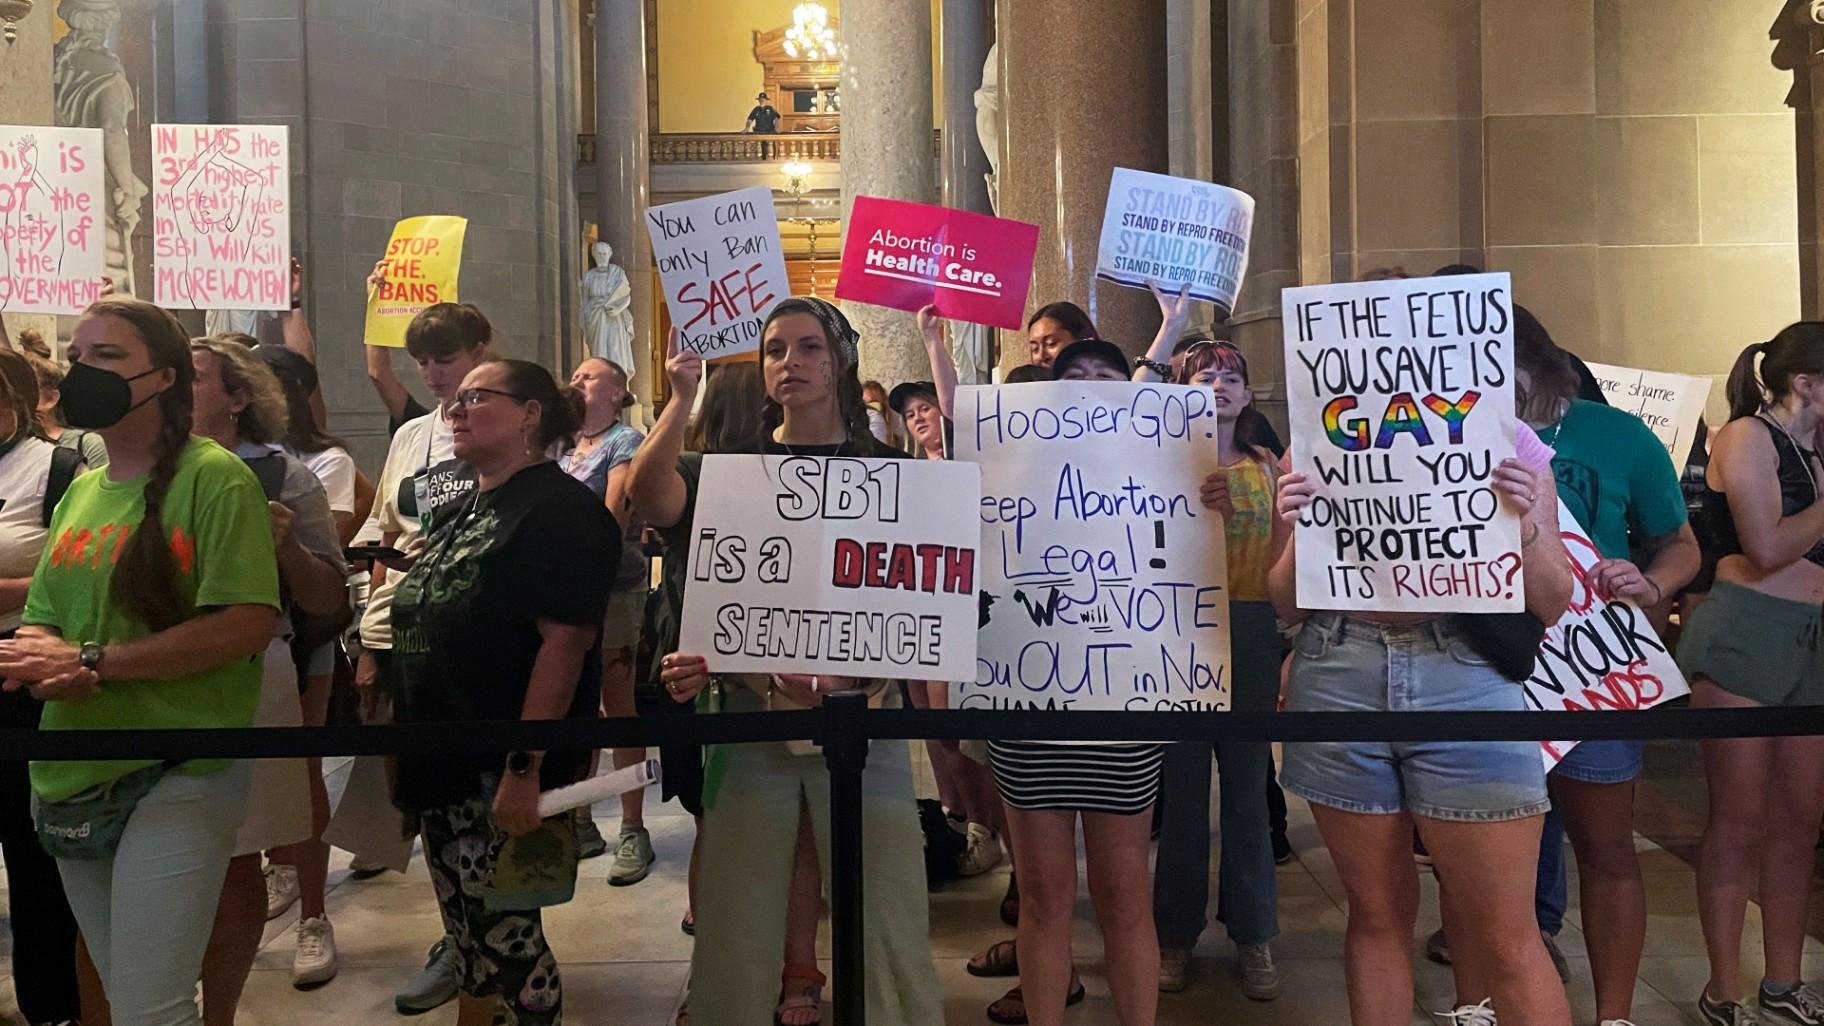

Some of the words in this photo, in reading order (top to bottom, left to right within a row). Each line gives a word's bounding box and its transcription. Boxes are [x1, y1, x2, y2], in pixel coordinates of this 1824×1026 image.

[59, 141, 85, 173] is
[157, 127, 177, 154] IN
[194, 127, 241, 155] HAS
[250, 132, 280, 159] the
[160, 153, 199, 186] 3rd
[205, 161, 281, 193] highest
[0, 182, 33, 213] OT
[50, 187, 91, 213] the
[251, 194, 285, 215] rate
[1125, 186, 1191, 221] STAND
[1194, 196, 1224, 227] BY
[1225, 206, 1249, 237] RO
[67, 216, 93, 252] of
[649, 210, 696, 241] You
[714, 201, 757, 226] can
[1121, 212, 1159, 232] STAND
[1160, 218, 1177, 235] BY
[1177, 222, 1208, 240] REPRO
[16, 247, 55, 275] the
[388, 238, 440, 256] STOP.
[659, 247, 710, 278] only
[722, 235, 769, 260] Ban
[868, 228, 955, 258] Abortion
[961, 243, 977, 261] is
[1118, 229, 1182, 264] STAND
[1185, 241, 1213, 269] BY
[158, 266, 219, 303] MORE
[221, 266, 286, 305] WOMEN
[865, 248, 940, 277] Health
[945, 262, 1002, 289] Care.
[1113, 255, 1151, 275] STAND
[1152, 262, 1168, 279] BY
[1168, 265, 1197, 283] REPRO
[0, 276, 101, 309] OVERNMENT
[677, 262, 776, 331] SAFE
[1297, 300, 1323, 342] IF
[1329, 297, 1392, 339] THE
[1406, 288, 1508, 339] FETUS
[1297, 347, 1369, 397] YOU
[1373, 345, 1460, 394] SAVE
[1470, 339, 1505, 388] IS
[1628, 372, 1675, 401] shame.
[1322, 390, 1482, 451] GAY
[430, 471, 454, 485] ANS
[442, 480, 474, 492] OUR
[1313, 453, 1404, 486] WILL
[1416, 449, 1491, 486] YOU
[430, 490, 466, 508] ODIE
[777, 456, 900, 522] SB1
[980, 496, 1037, 555] eep
[1054, 462, 1196, 521] Abortion
[1442, 487, 1498, 522] TO
[695, 528, 747, 583] is
[757, 536, 792, 583] a
[832, 538, 975, 596] DEATH
[1335, 524, 1485, 562] PROTECT
[1327, 565, 1376, 599] ITS
[1392, 552, 1522, 600] RIGHTS?
[1013, 586, 1079, 627] We
[1080, 604, 1109, 625] will
[1109, 582, 1222, 637] VOTE
[714, 603, 942, 666] SENTENCE
[1542, 601, 1666, 687] YOUR
[960, 657, 1012, 693] ou
[1018, 641, 1133, 697] OUT
[1133, 665, 1158, 693] in
[1161, 642, 1227, 694] Nov.
